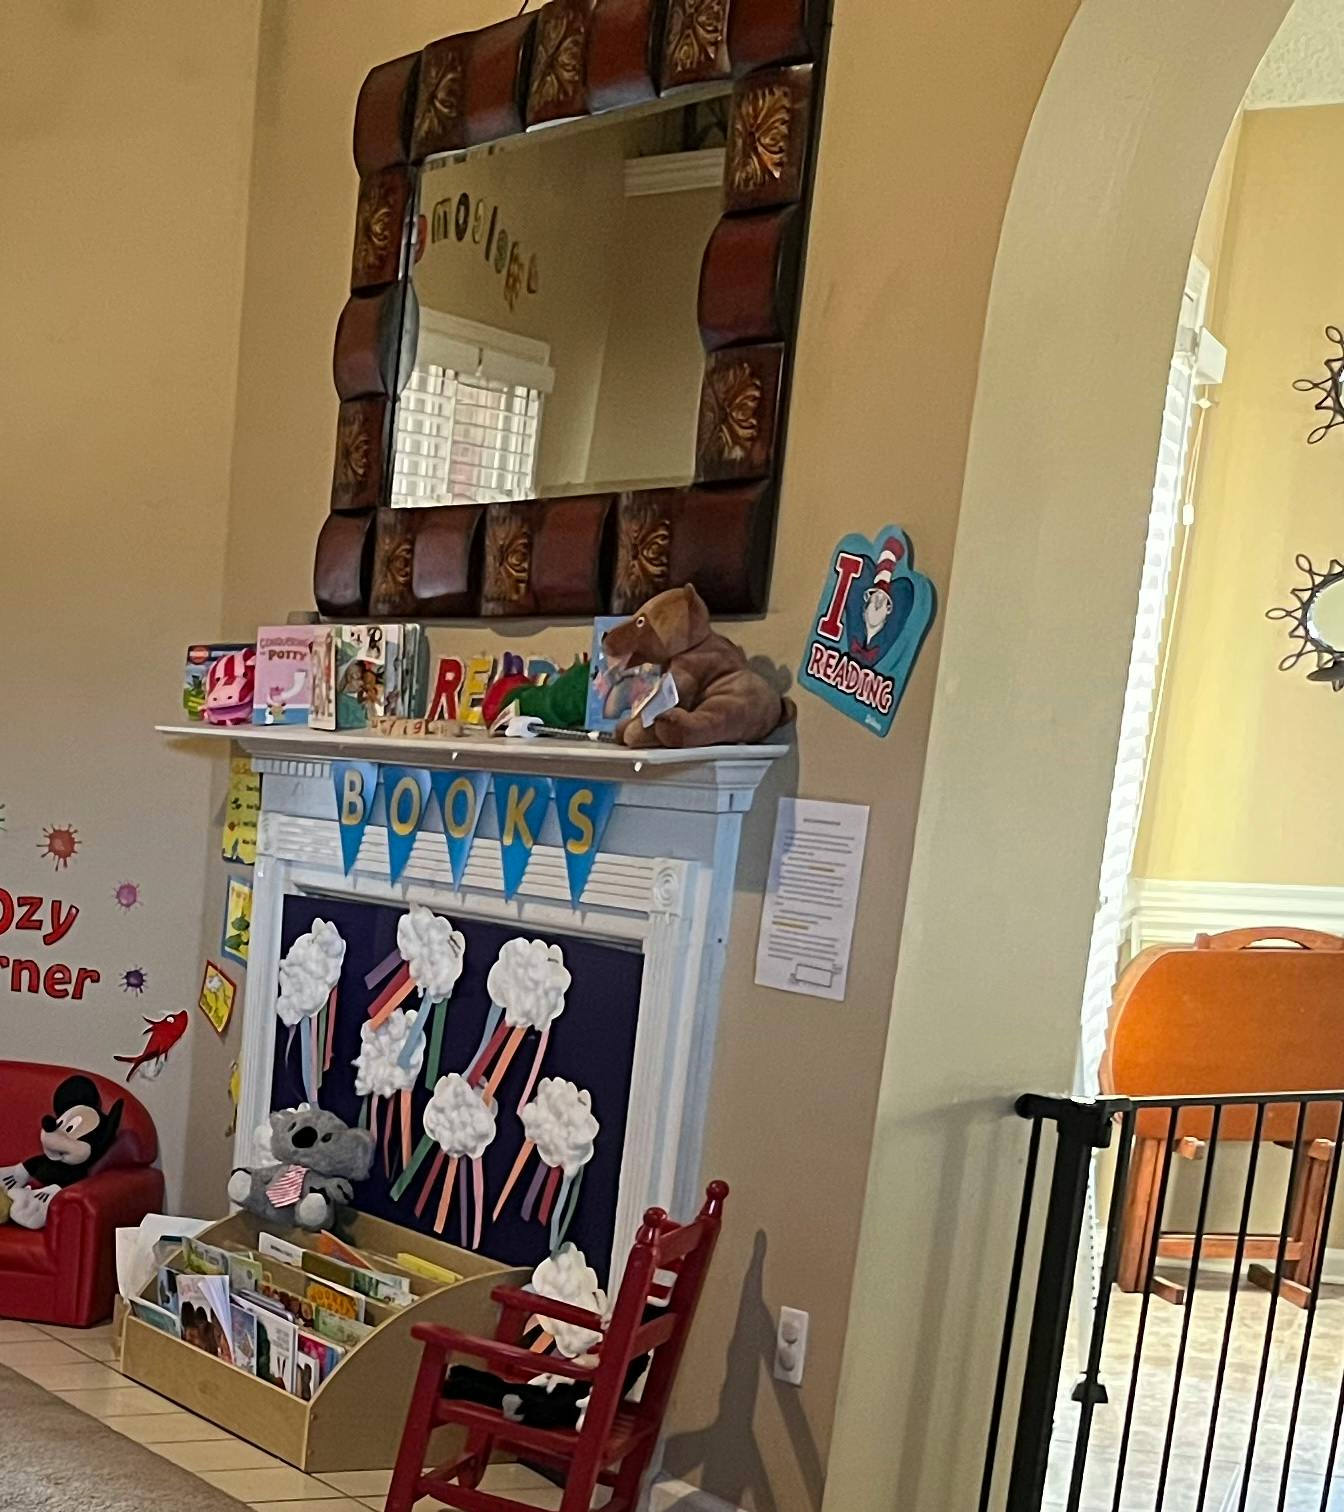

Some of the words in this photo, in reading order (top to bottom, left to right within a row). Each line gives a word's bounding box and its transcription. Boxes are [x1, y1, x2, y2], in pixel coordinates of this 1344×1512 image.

[816, 551, 864, 642] I
[268, 649, 307, 661] POTTY
[807, 641, 895, 714] READING
[341, 768, 595, 855] BOOKS
